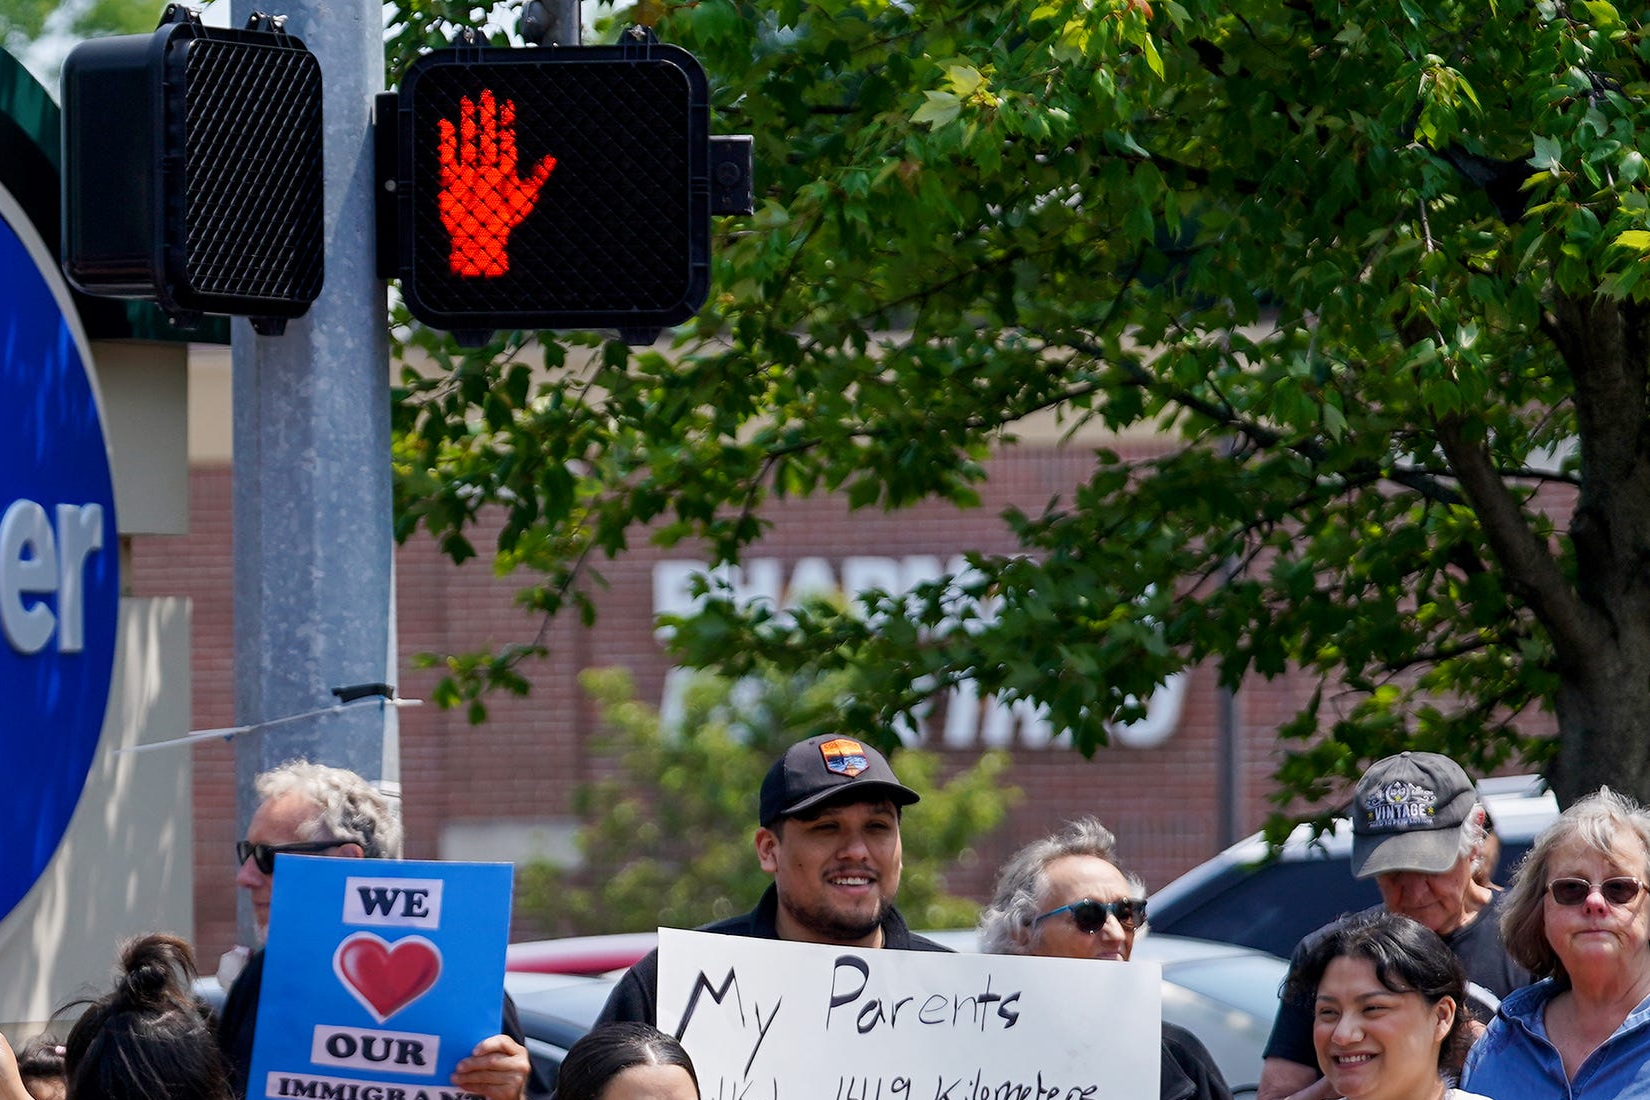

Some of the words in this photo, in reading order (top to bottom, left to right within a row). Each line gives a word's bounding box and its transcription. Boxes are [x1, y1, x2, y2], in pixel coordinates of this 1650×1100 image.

[1374, 803, 1427, 820] VINTAGE
[357, 886, 429, 918] WE
[676, 966, 782, 1078] My
[825, 954, 1022, 1035] Parents
[325, 1032, 426, 1066] OUR
